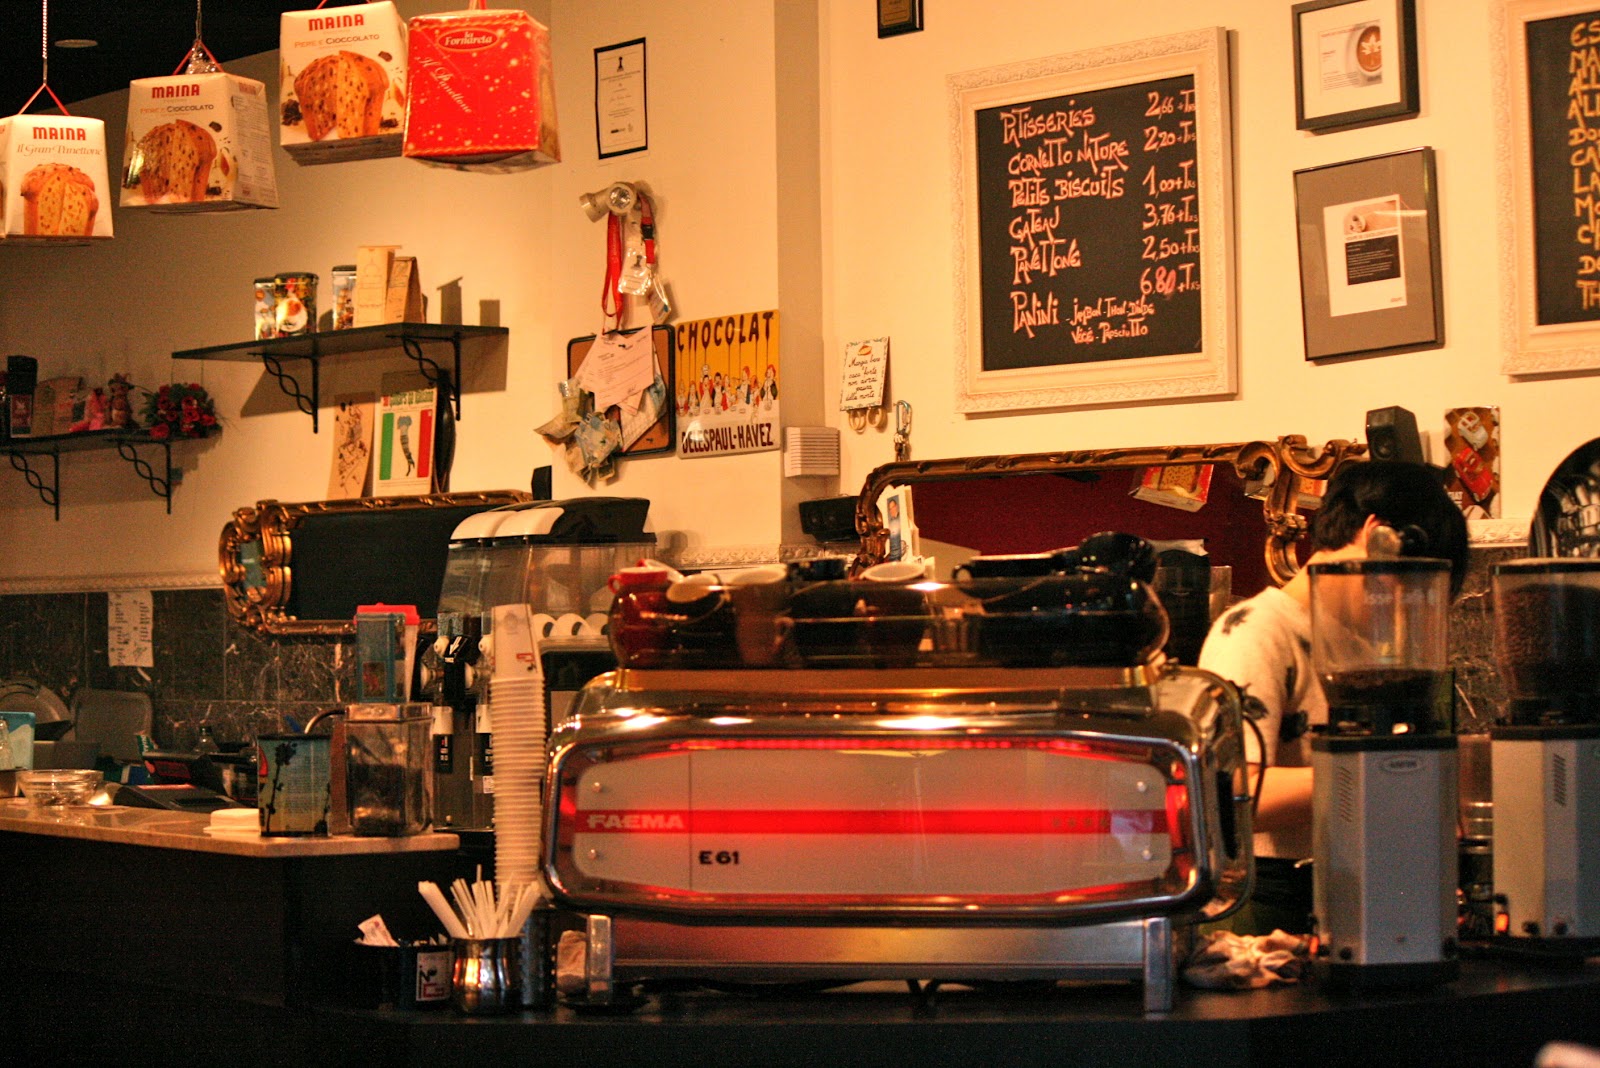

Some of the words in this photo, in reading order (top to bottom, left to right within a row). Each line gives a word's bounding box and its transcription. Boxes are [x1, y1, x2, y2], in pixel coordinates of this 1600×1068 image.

[308, 14, 364, 31] MAINA
[325, 34, 380, 45] CIOCCOLATO
[152, 84, 200, 99] MAINA
[166, 104, 214, 113] CIOCCOLATO
[32, 127, 87, 141] MAINA
[677, 311, 774, 353] CHOCOLAT
[587, 814, 684, 829] FAEMA
[699, 851, 713, 865] E
[716, 851, 740, 865] 61
